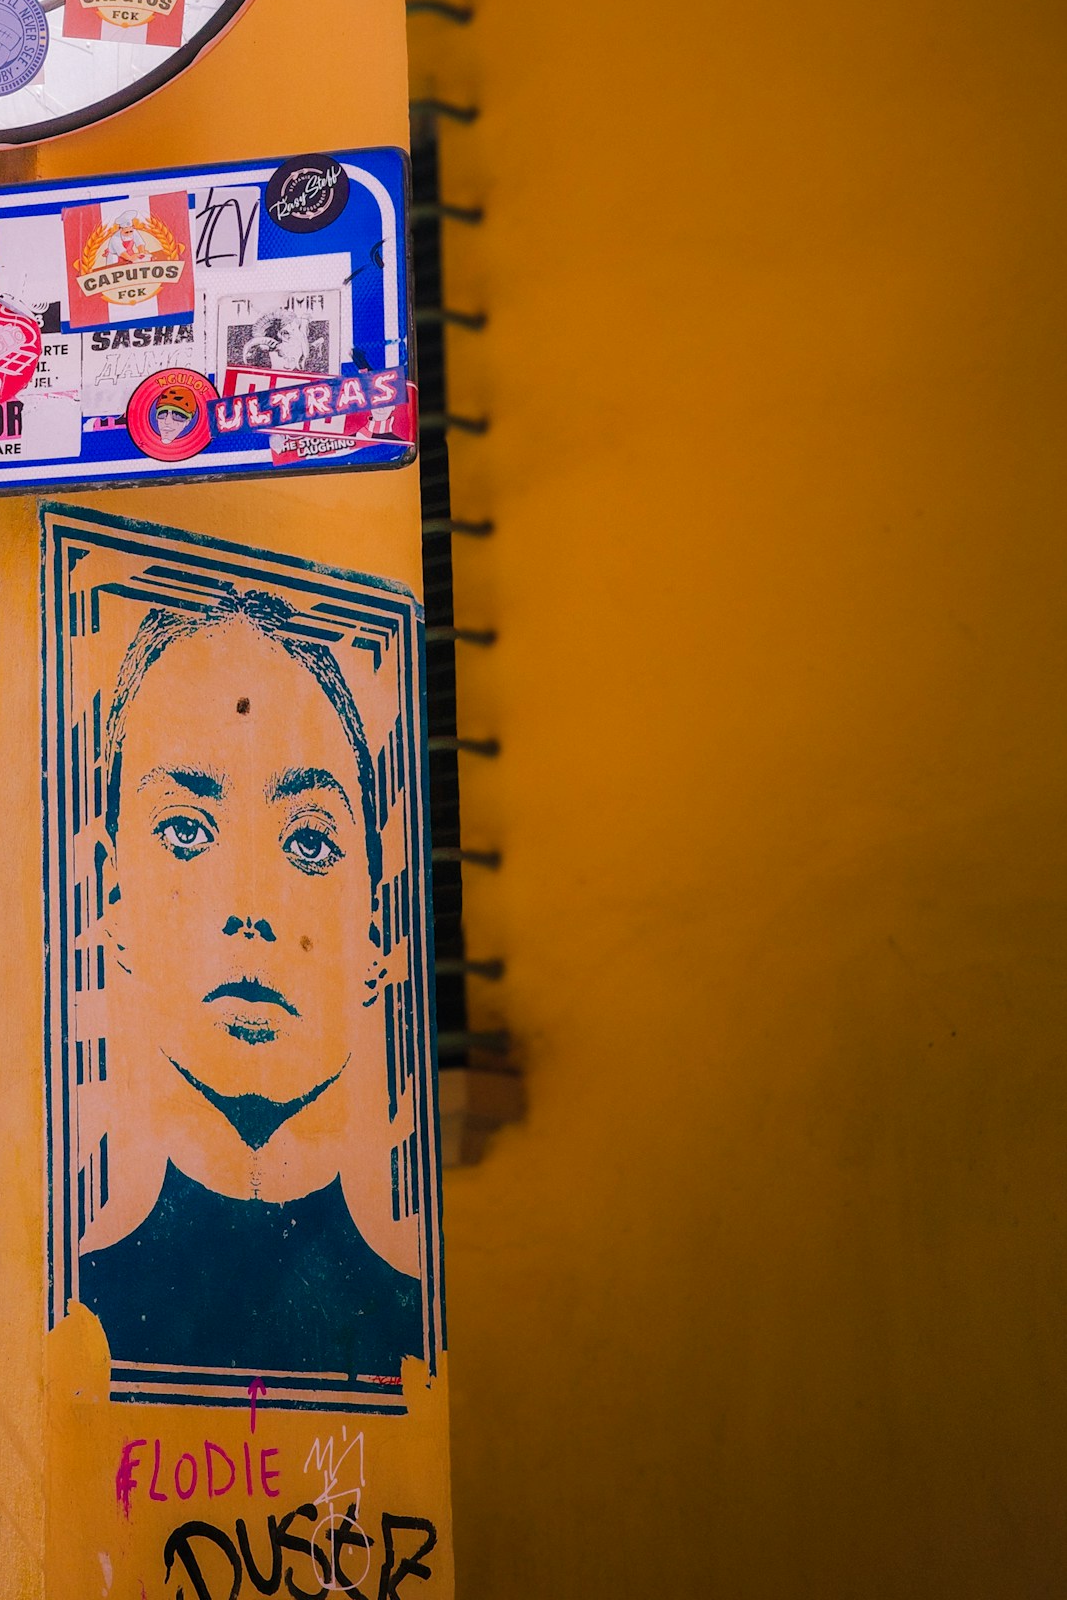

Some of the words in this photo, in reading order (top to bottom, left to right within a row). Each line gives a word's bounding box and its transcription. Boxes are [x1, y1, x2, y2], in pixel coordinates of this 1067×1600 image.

[19, 8, 37, 41] NEVER
[112, 10, 139, 20] FCK
[18, 45, 34, 68] SEE
[84, 265, 179, 292] CAPUTOS
[118, 288, 147, 299] FCK
[217, 372, 398, 432] ULTRAS
[297, 440, 354, 457] LAUGHING
